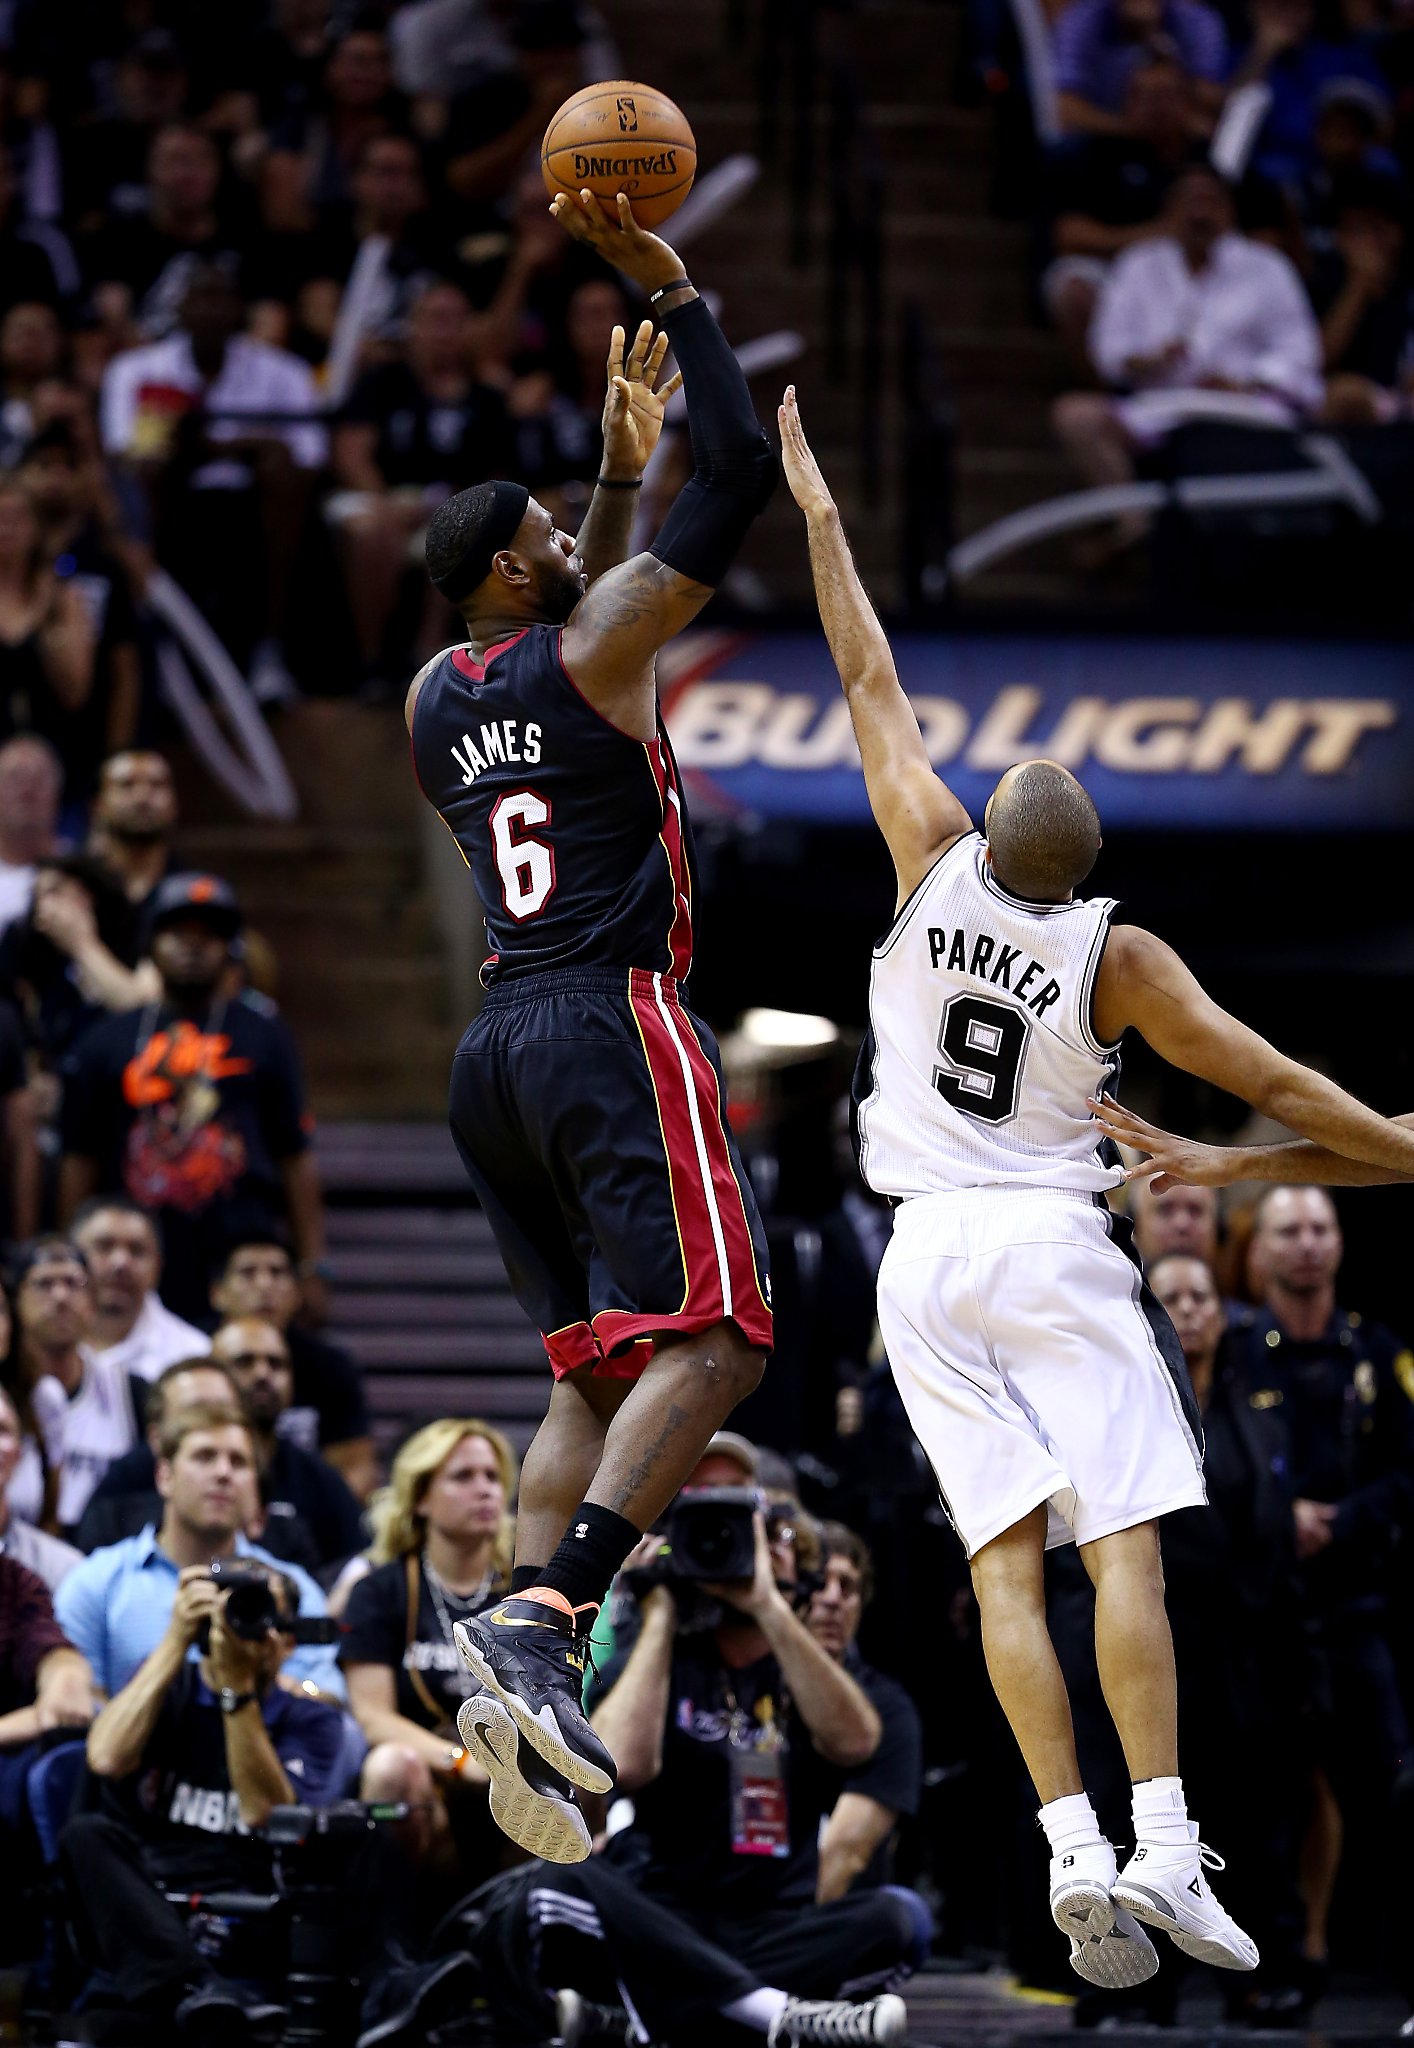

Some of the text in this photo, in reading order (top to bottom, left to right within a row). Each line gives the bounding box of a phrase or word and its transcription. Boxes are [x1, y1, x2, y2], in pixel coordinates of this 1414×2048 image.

[575, 150, 677, 178] SPALDING
[451, 719, 542, 786] JAMES
[964, 684, 1396, 775] LIGHT
[488, 786, 557, 924] 6
[927, 927, 1061, 1019] PARKER
[931, 989, 1033, 1128] 9
